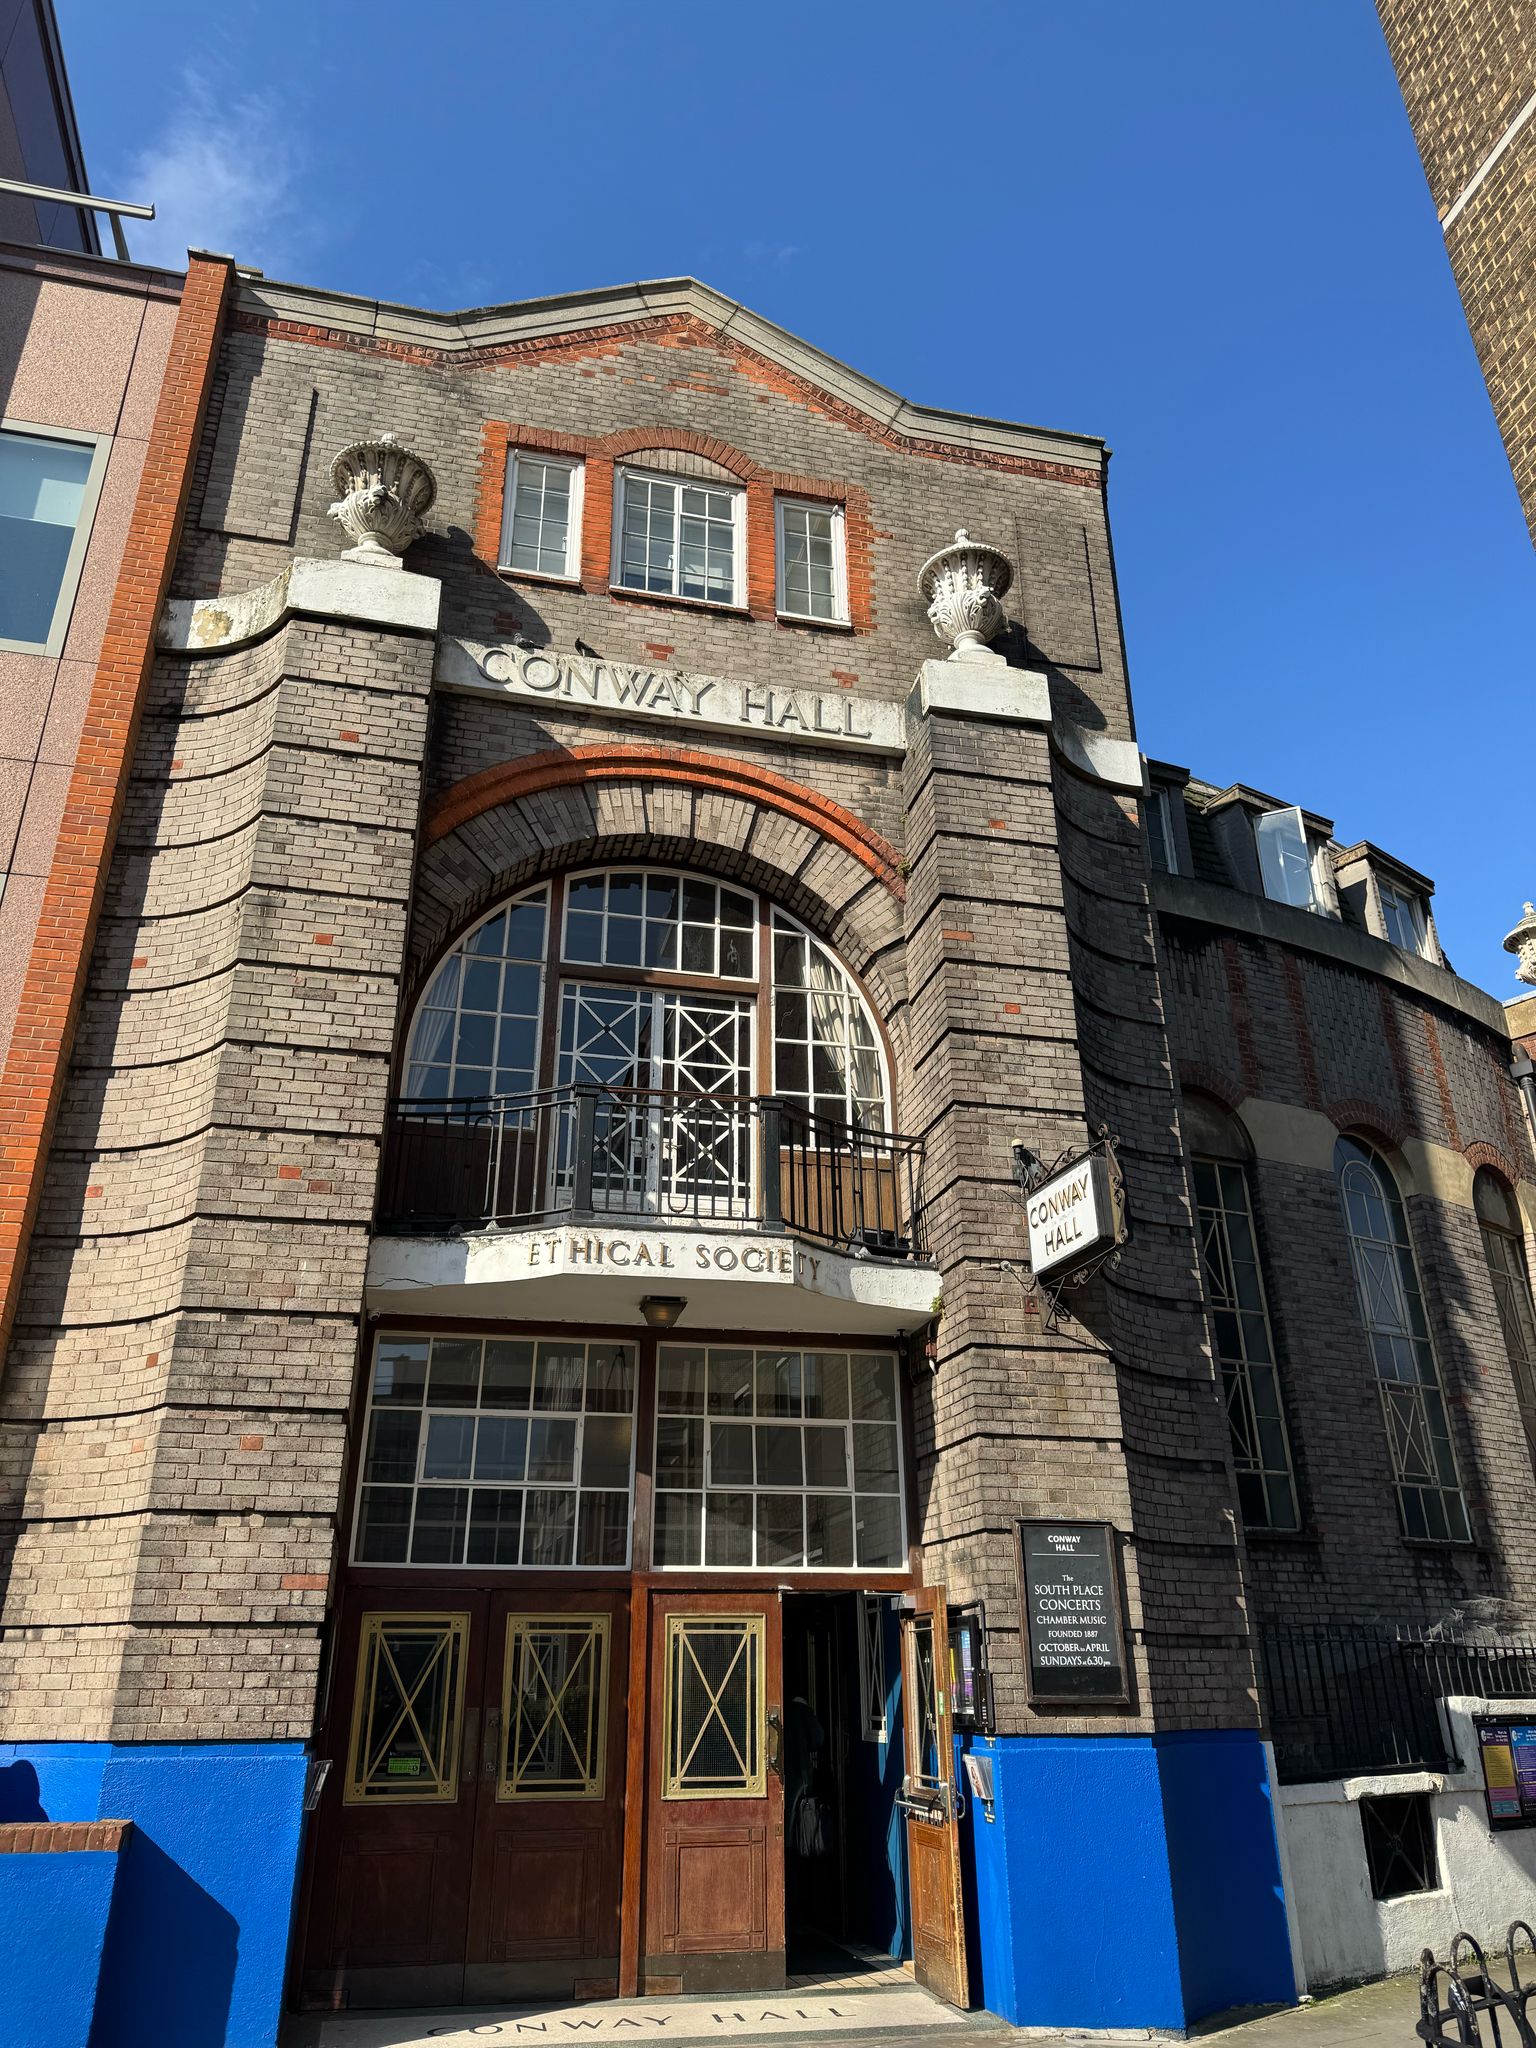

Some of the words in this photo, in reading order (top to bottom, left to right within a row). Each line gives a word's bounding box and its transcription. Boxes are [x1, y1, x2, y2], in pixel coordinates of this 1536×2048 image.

[477, 647, 715, 716] CONWAY
[738, 685, 873, 738] HALL
[1030, 1173, 1089, 1229] CONWAY
[1045, 1217, 1082, 1256] HALL
[526, 1235, 675, 1268] ETHICAL
[696, 1244, 821, 1281] SOCIETY
[1047, 1535, 1081, 1544] CONWAY
[1055, 1544, 1075, 1552] HALL
[1062, 1574, 1074, 1582] The
[1034, 1584, 1070, 1596] SOUTH
[1073, 1585, 1104, 1596] PLACE
[1039, 1598, 1101, 1611] CONCERTS
[1036, 1615, 1079, 1625] CHAMBER
[1079, 1615, 1107, 1625] MUSIC
[1048, 1630, 1083, 1638] FOUNDED
[1084, 1630, 1098, 1638] 1887
[1039, 1643, 1080, 1652] OCTOBER
[1086, 1643, 1110, 1652] APRIL
[1040, 1655, 1082, 1666] SUNDAYS
[426, 2015, 673, 2038] CONWAY
[711, 2008, 857, 2024] HALL
